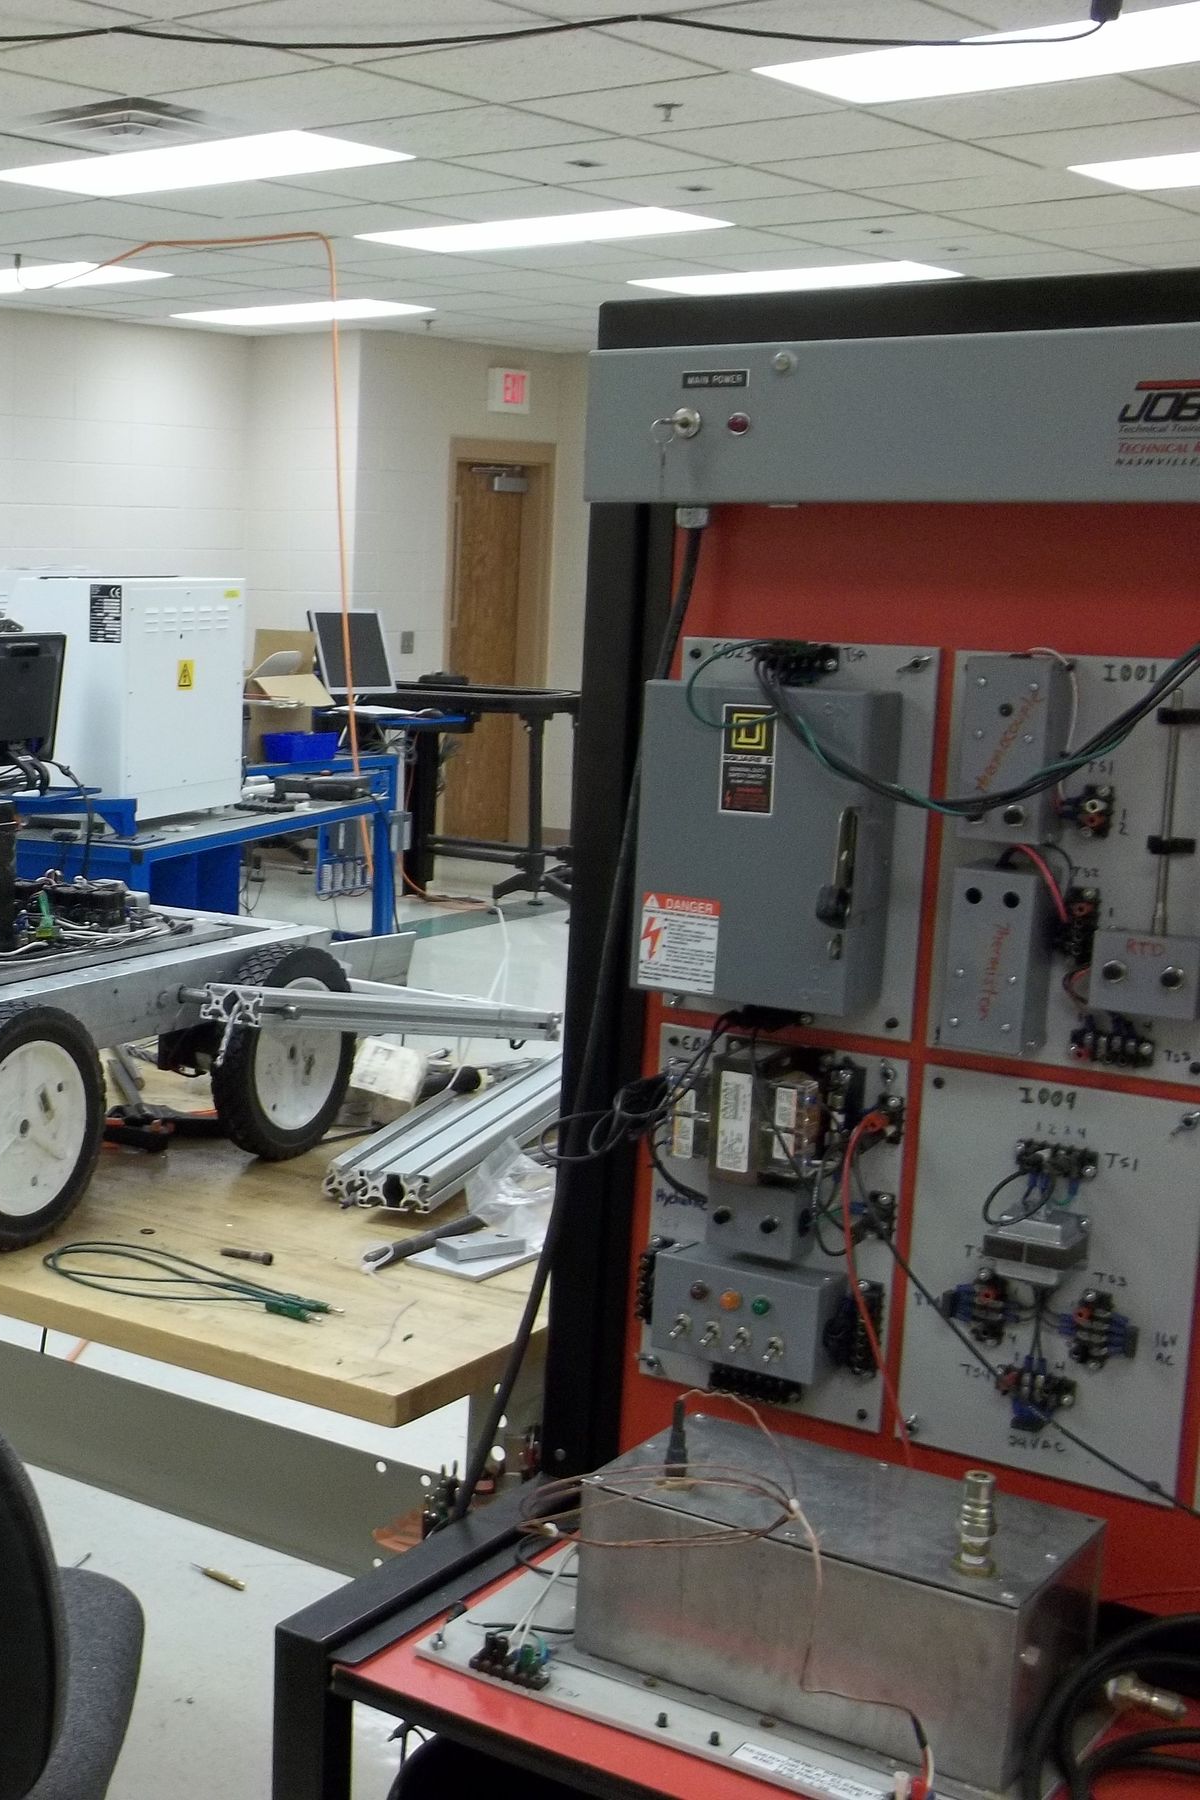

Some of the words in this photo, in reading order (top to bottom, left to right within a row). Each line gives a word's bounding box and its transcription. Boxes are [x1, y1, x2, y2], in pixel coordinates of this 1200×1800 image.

[687, 375, 709, 384] MAIN
[712, 374, 742, 384] POWER
[665, 898, 714, 915] DANGER
[1104, 1152, 1140, 1172] TS1
